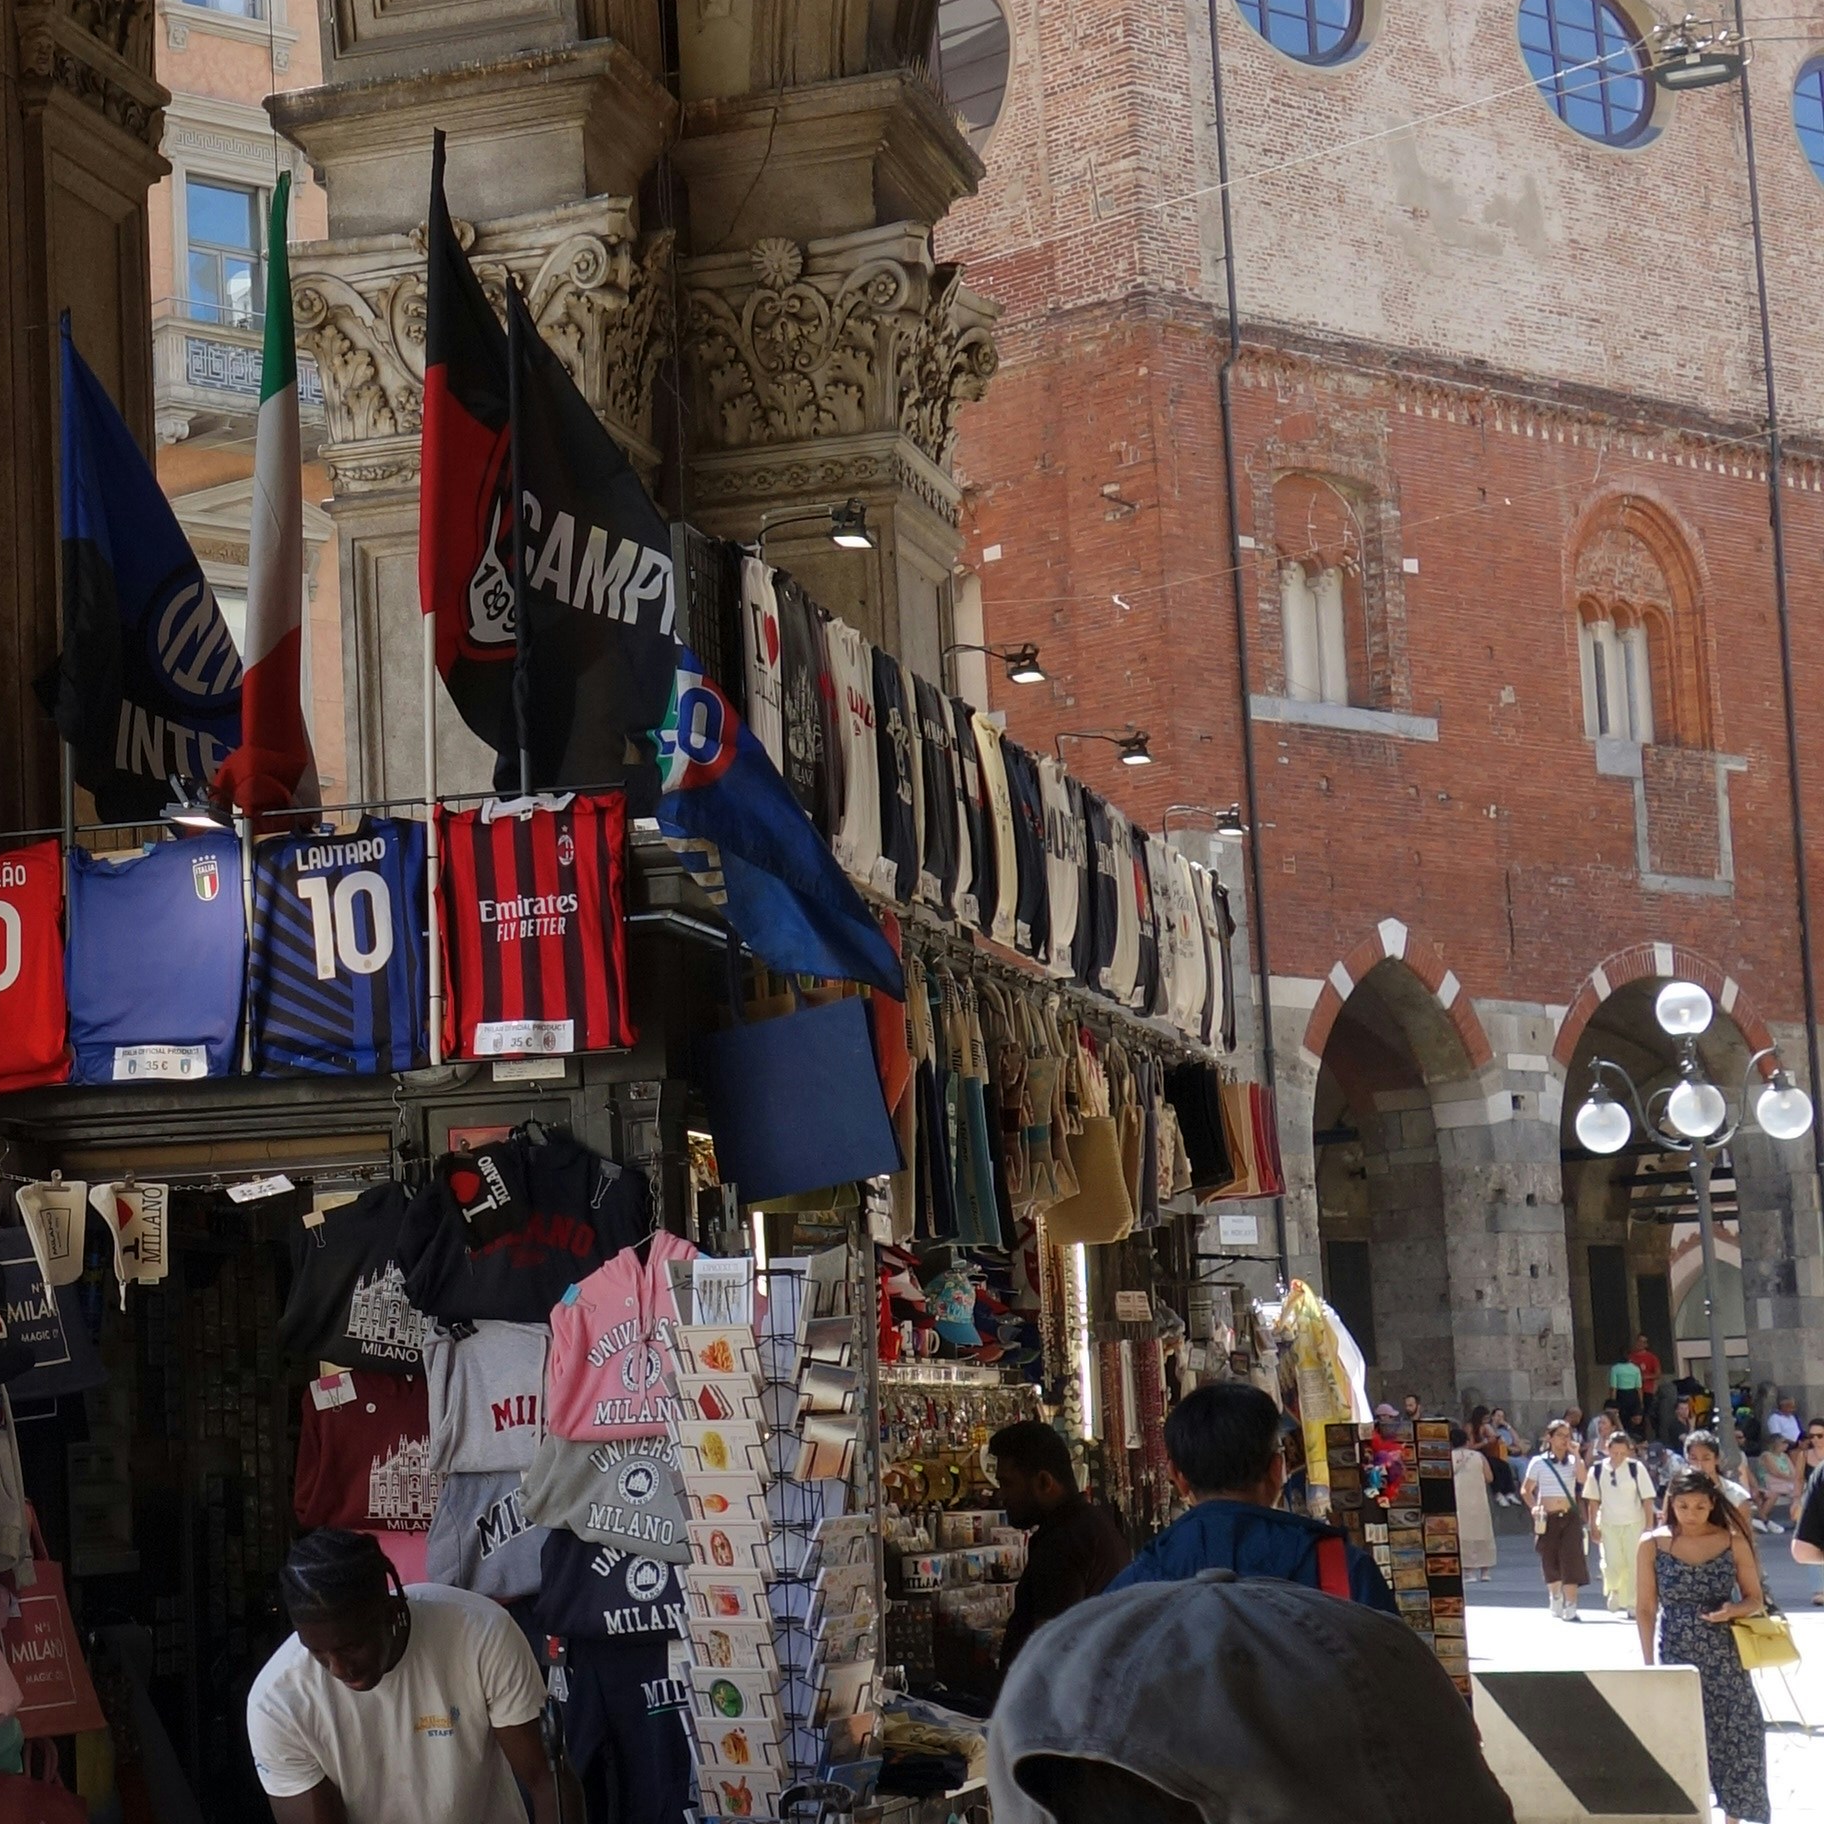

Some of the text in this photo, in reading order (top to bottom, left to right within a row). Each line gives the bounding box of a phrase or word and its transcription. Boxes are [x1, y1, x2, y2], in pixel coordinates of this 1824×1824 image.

[295, 837, 386, 872] LAUTARO
[194, 864, 215, 875] ITALIA
[478, 893, 578, 923] Emirates
[297, 870, 394, 980] 10
[497, 916, 566, 942] FLY BETTER
[510, 1037, 533, 1047] 35 €
[532, 1024, 567, 1032] PRODUCT
[145, 1060, 168, 1071] 35 €
[477, 1155, 511, 1206] MILANO
[462, 1194, 497, 1223] I
[141, 1187, 163, 1264] MILANO
[361, 1341, 418, 1363] MILANO
[586, 1503, 674, 1546] MILANO
